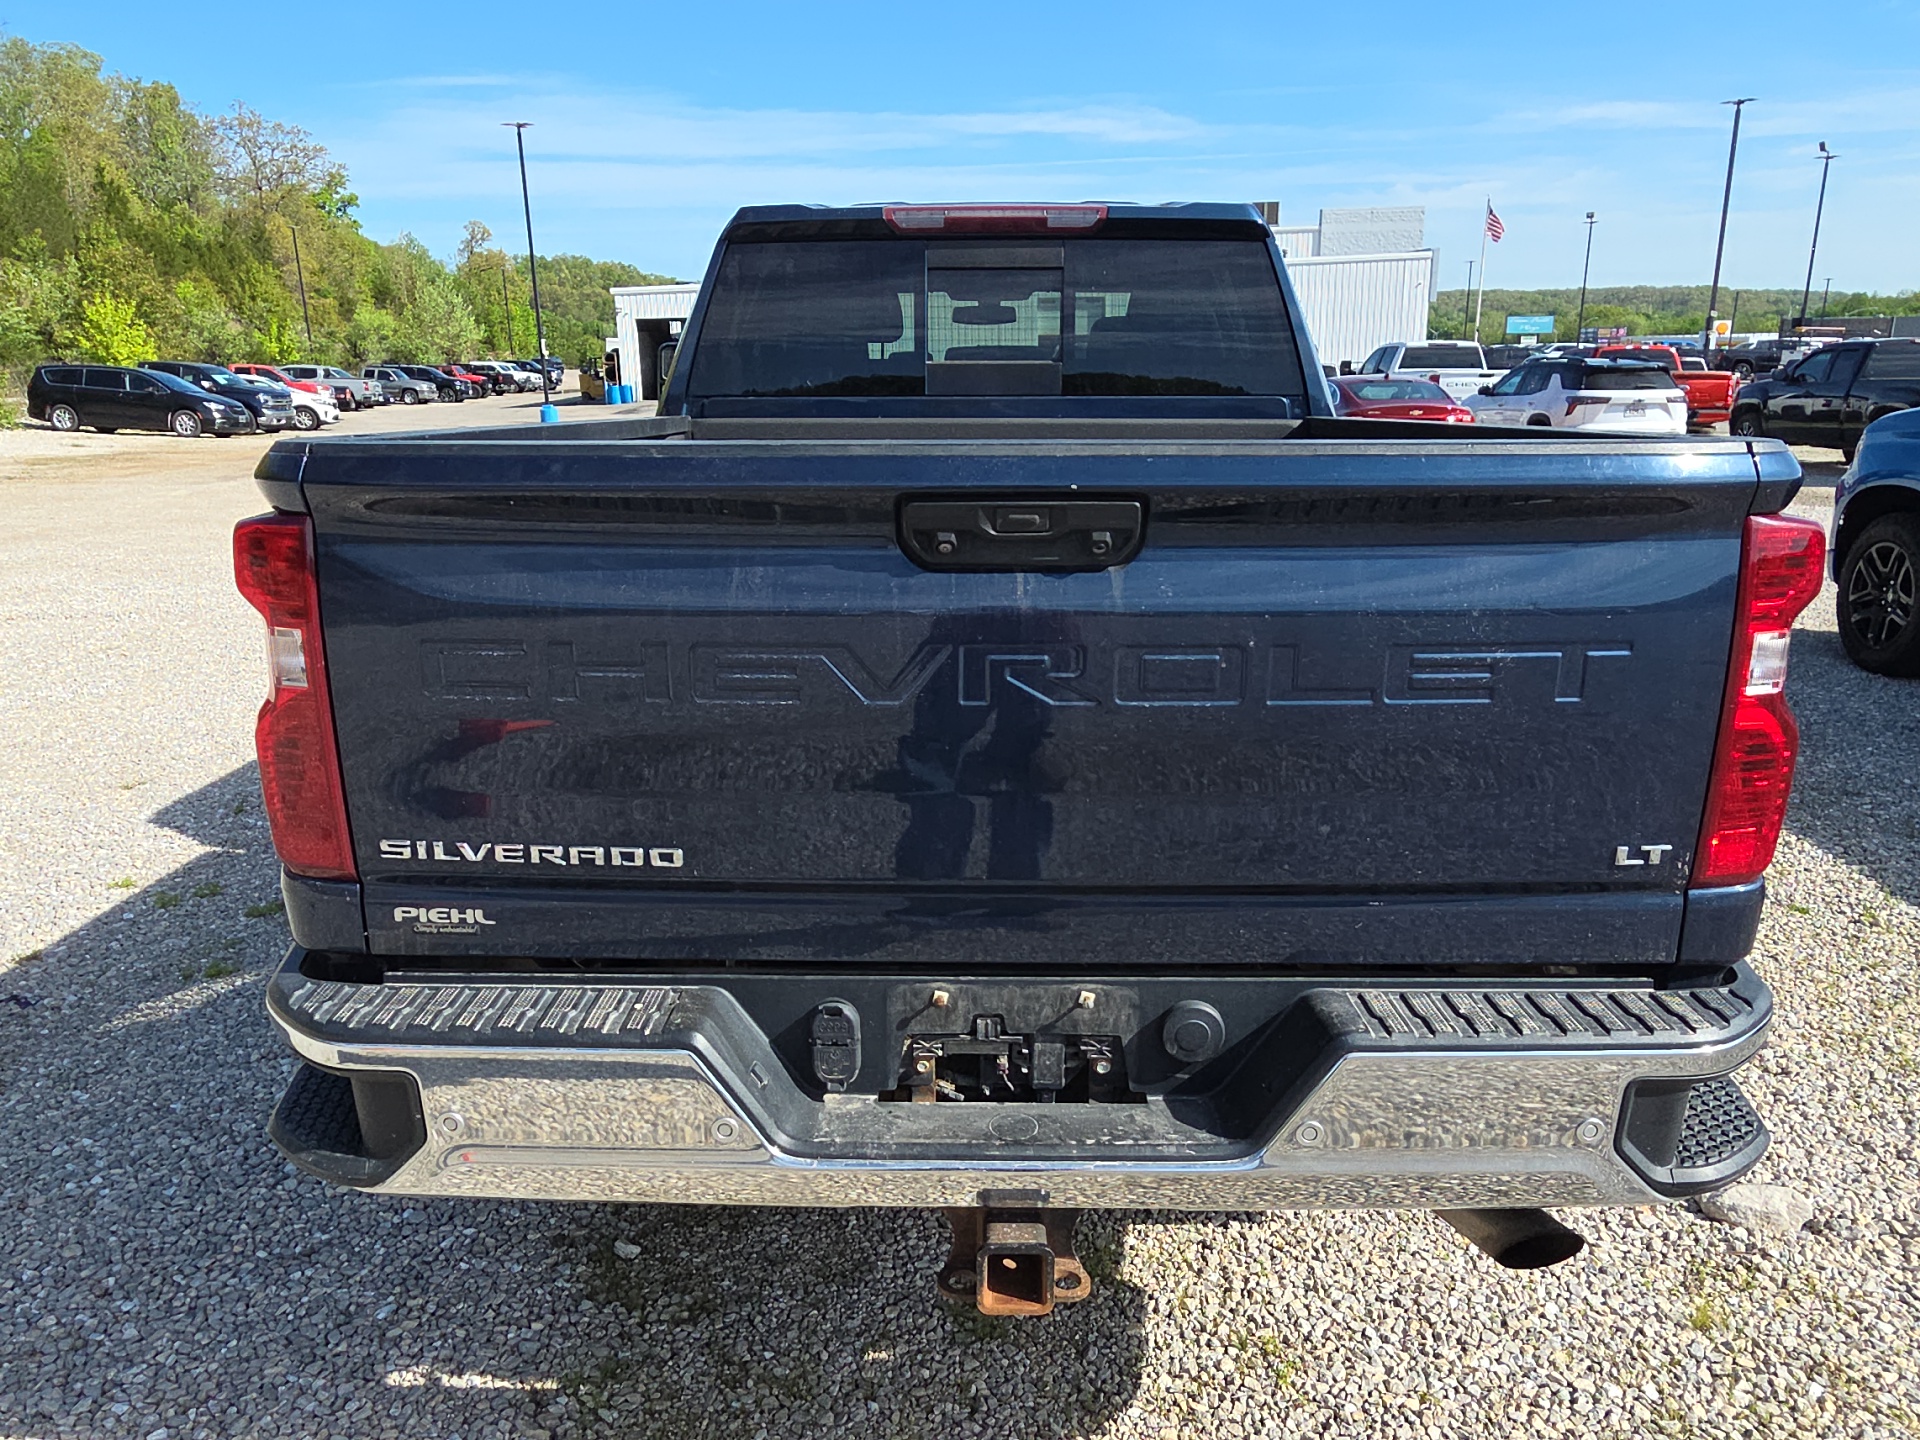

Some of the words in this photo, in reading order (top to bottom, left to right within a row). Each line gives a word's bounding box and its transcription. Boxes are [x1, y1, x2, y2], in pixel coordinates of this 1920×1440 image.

[420, 638, 1633, 705] CHEVROLET
[379, 838, 684, 868] SILVERADO
[1614, 843, 1673, 866] LT
[393, 906, 496, 925] PIEHL
